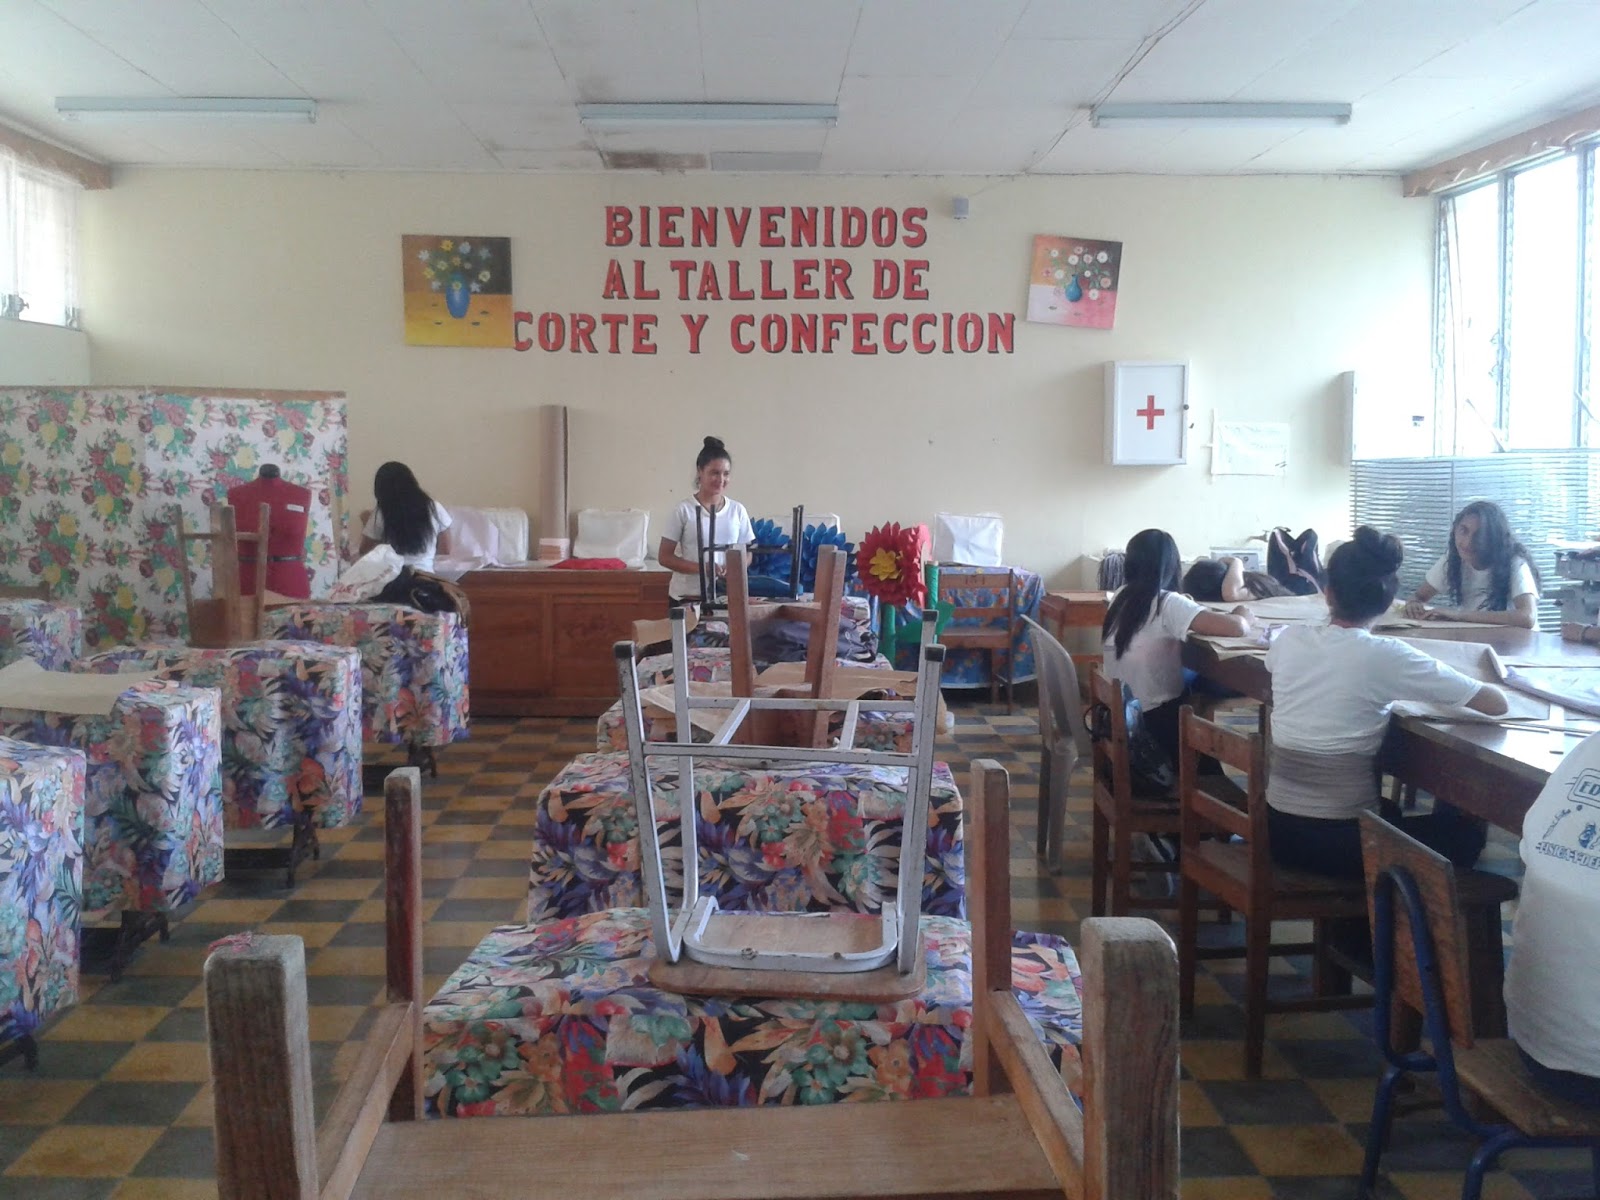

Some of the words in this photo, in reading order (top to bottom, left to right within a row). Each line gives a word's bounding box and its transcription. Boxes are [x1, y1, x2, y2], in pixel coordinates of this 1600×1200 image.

[604, 206, 928, 247] BIENVENIDOS
[602, 259, 660, 300] AL
[670, 259, 854, 300] TALLER
[873, 259, 930, 300] DE
[512, 311, 658, 354] CORTE
[681, 313, 709, 354] Y
[730, 312, 1015, 354] CONFECCION
